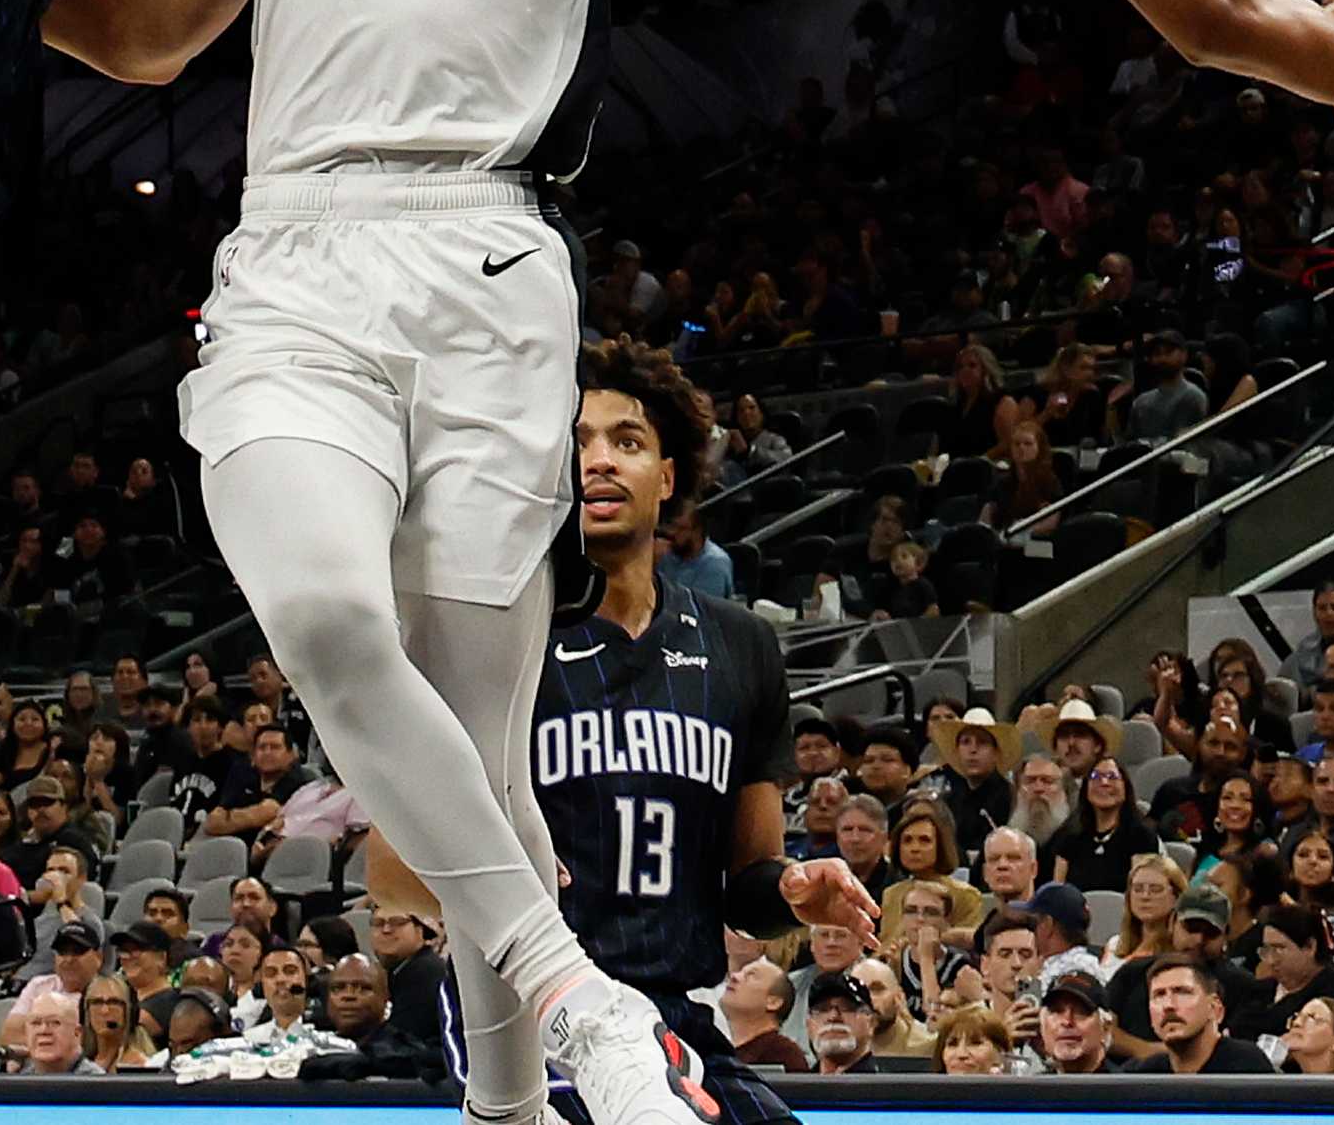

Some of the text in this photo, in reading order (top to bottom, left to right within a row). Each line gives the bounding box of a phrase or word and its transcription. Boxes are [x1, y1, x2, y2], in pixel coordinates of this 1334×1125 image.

[661, 647, 709, 670] Disney
[536, 707, 734, 795] ORLANDO
[615, 795, 677, 899] 13
